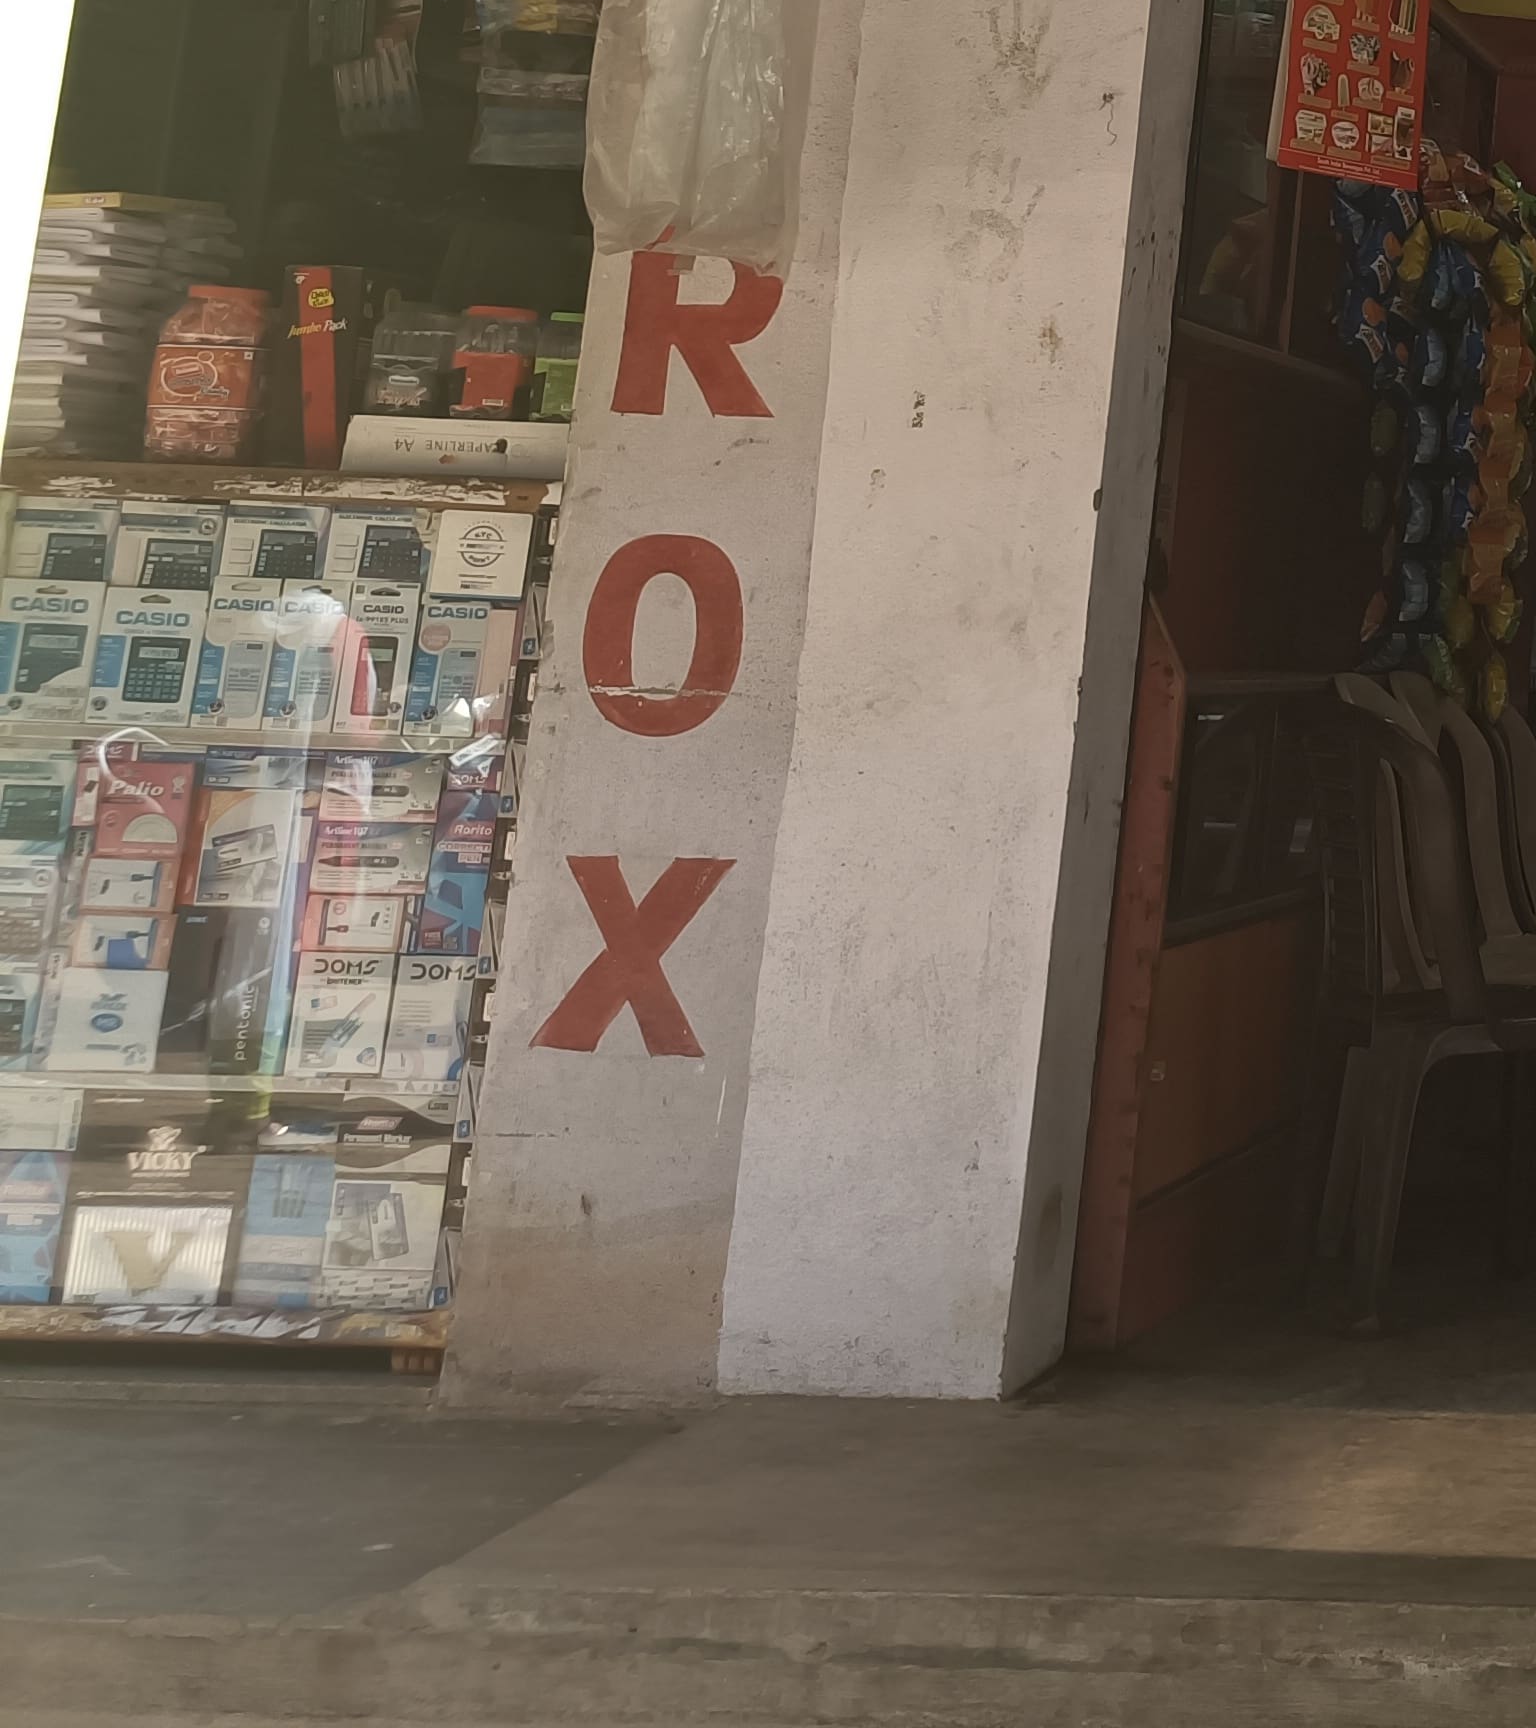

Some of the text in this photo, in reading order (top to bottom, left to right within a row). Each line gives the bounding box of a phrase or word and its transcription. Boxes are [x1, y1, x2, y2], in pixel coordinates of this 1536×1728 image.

[323, 317, 349, 332] Pack
[393, 438, 504, 454] APERLINE A4
[10, 596, 90, 614] CASIO
[213, 597, 275, 612] CASIO
[284, 599, 344, 615] CASIO
[362, 603, 405, 615] CASIO
[427, 605, 489, 620] CASIO
[116, 610, 191, 627] CASIO
[108, 780, 165, 797] Palio
[454, 824, 493, 836] Rorito
[313, 958, 380, 975] DOMS
[410, 963, 477, 981] DOMS
[234, 984, 256, 1061] pentonic
[127, 1150, 196, 1171] VICKY
